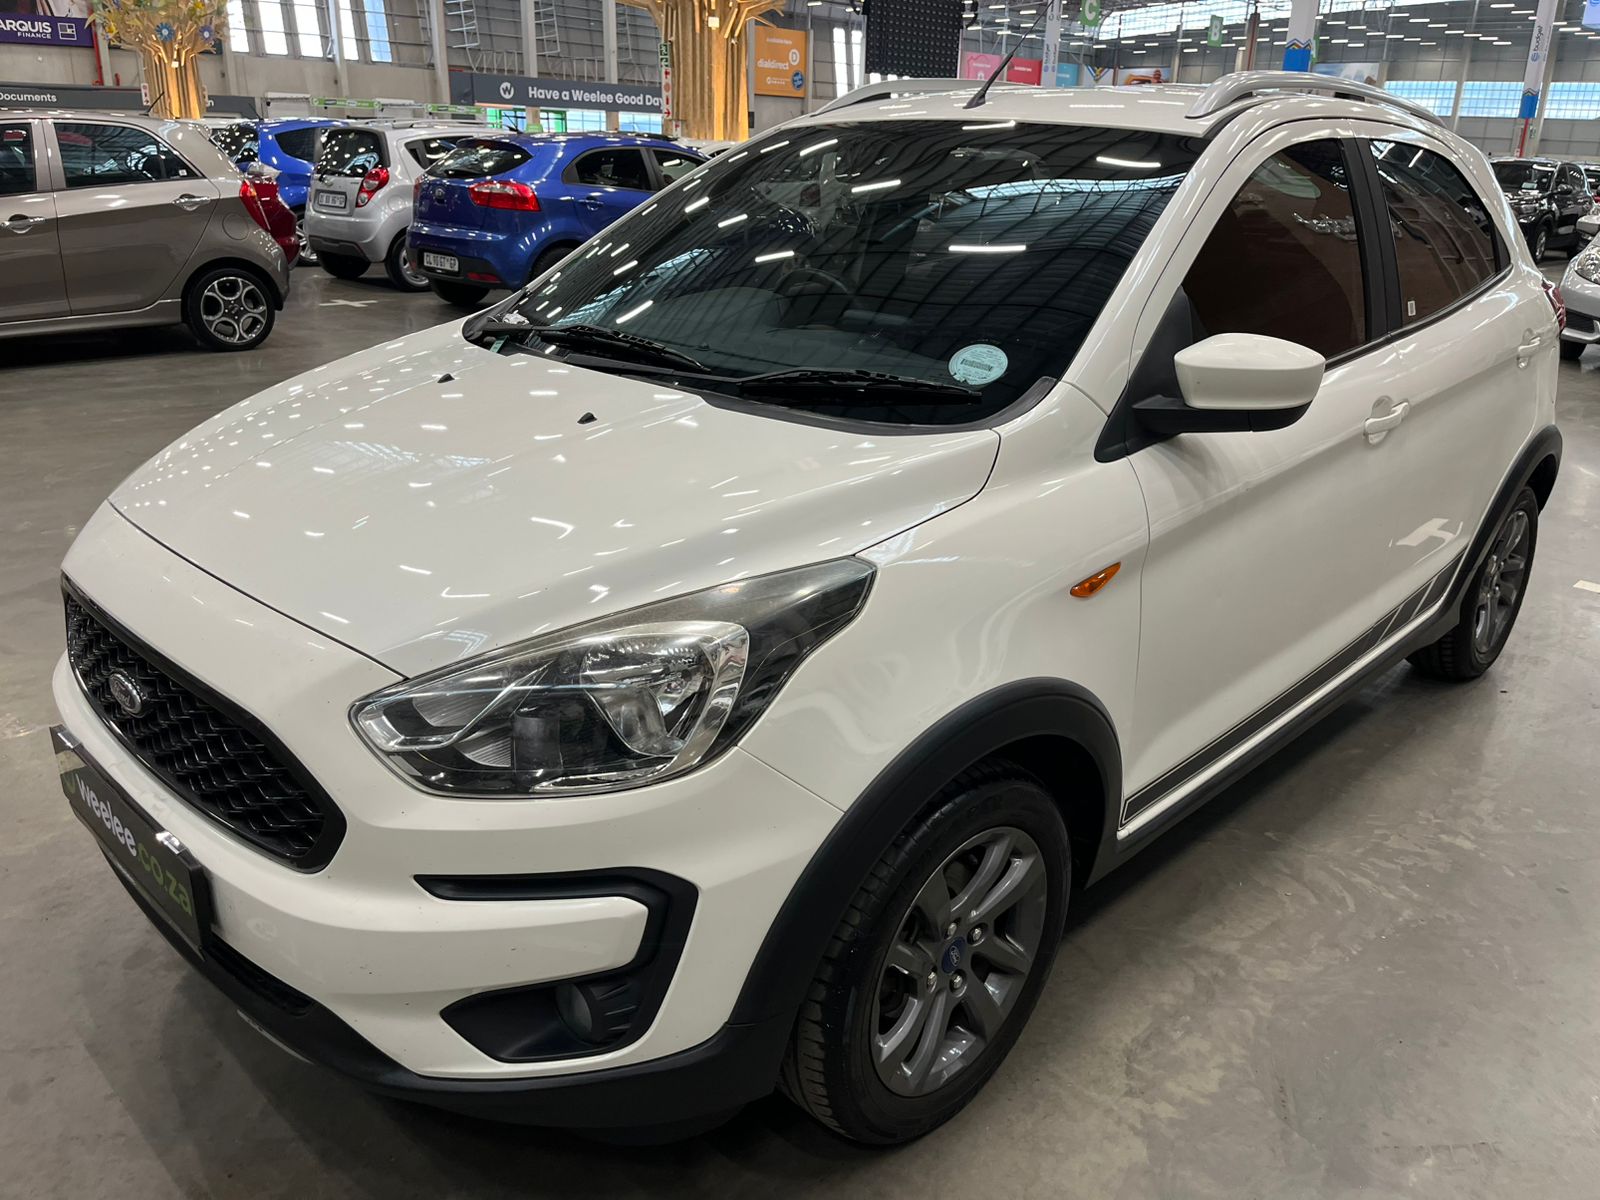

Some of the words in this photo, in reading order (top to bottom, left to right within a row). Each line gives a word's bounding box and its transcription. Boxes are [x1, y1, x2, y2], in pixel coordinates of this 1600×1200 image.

[1085, 0, 1097, 21] C
[17, 31, 52, 39] FINANCE
[528, 86, 560, 100] Have
[561, 91, 570, 101] a
[571, 89, 613, 103] Weelee
[615, 92, 643, 106] Good
[645, 94, 663, 109] Day
[75, 773, 192, 917] weelee.co.za
